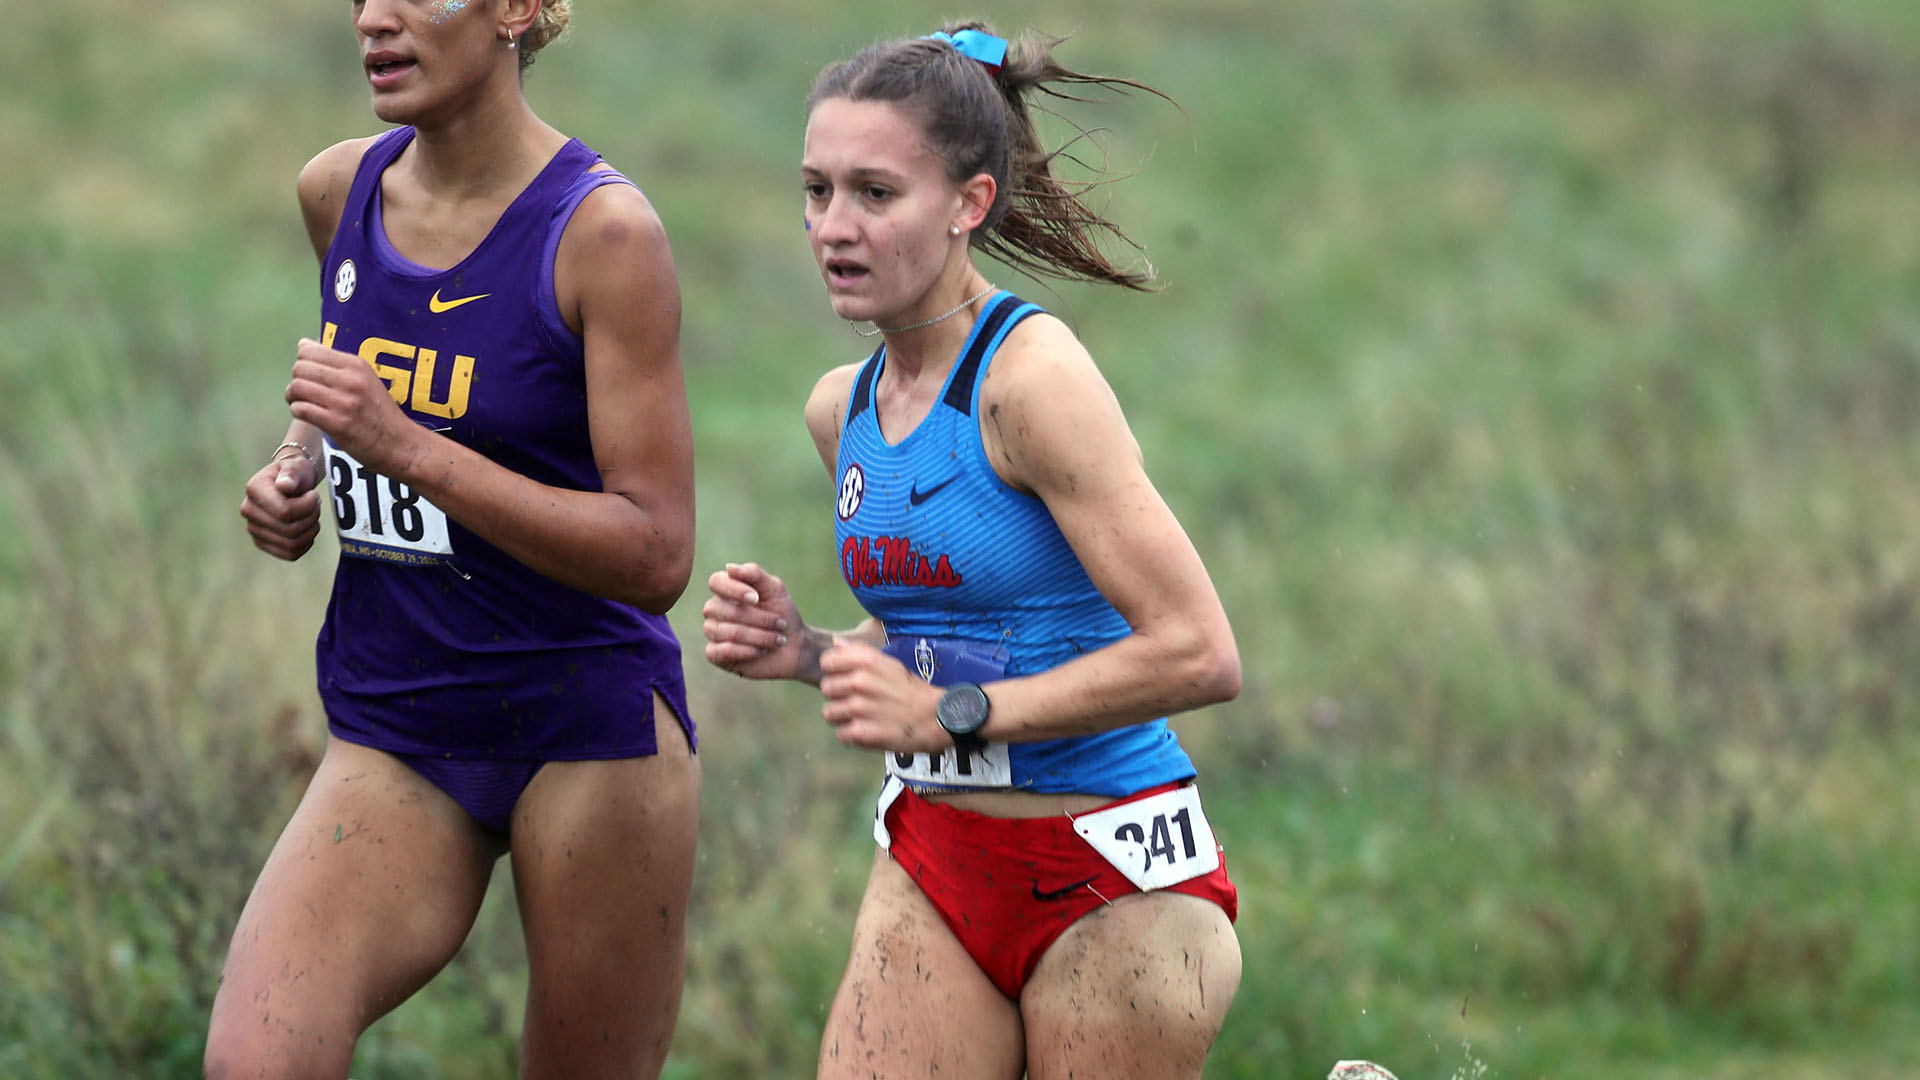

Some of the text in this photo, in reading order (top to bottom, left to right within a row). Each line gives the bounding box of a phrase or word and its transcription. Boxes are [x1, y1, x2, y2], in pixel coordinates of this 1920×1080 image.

[330, 455, 424, 542] 318
[838, 465, 864, 519] SEC
[842, 536, 962, 588] Ole Miss
